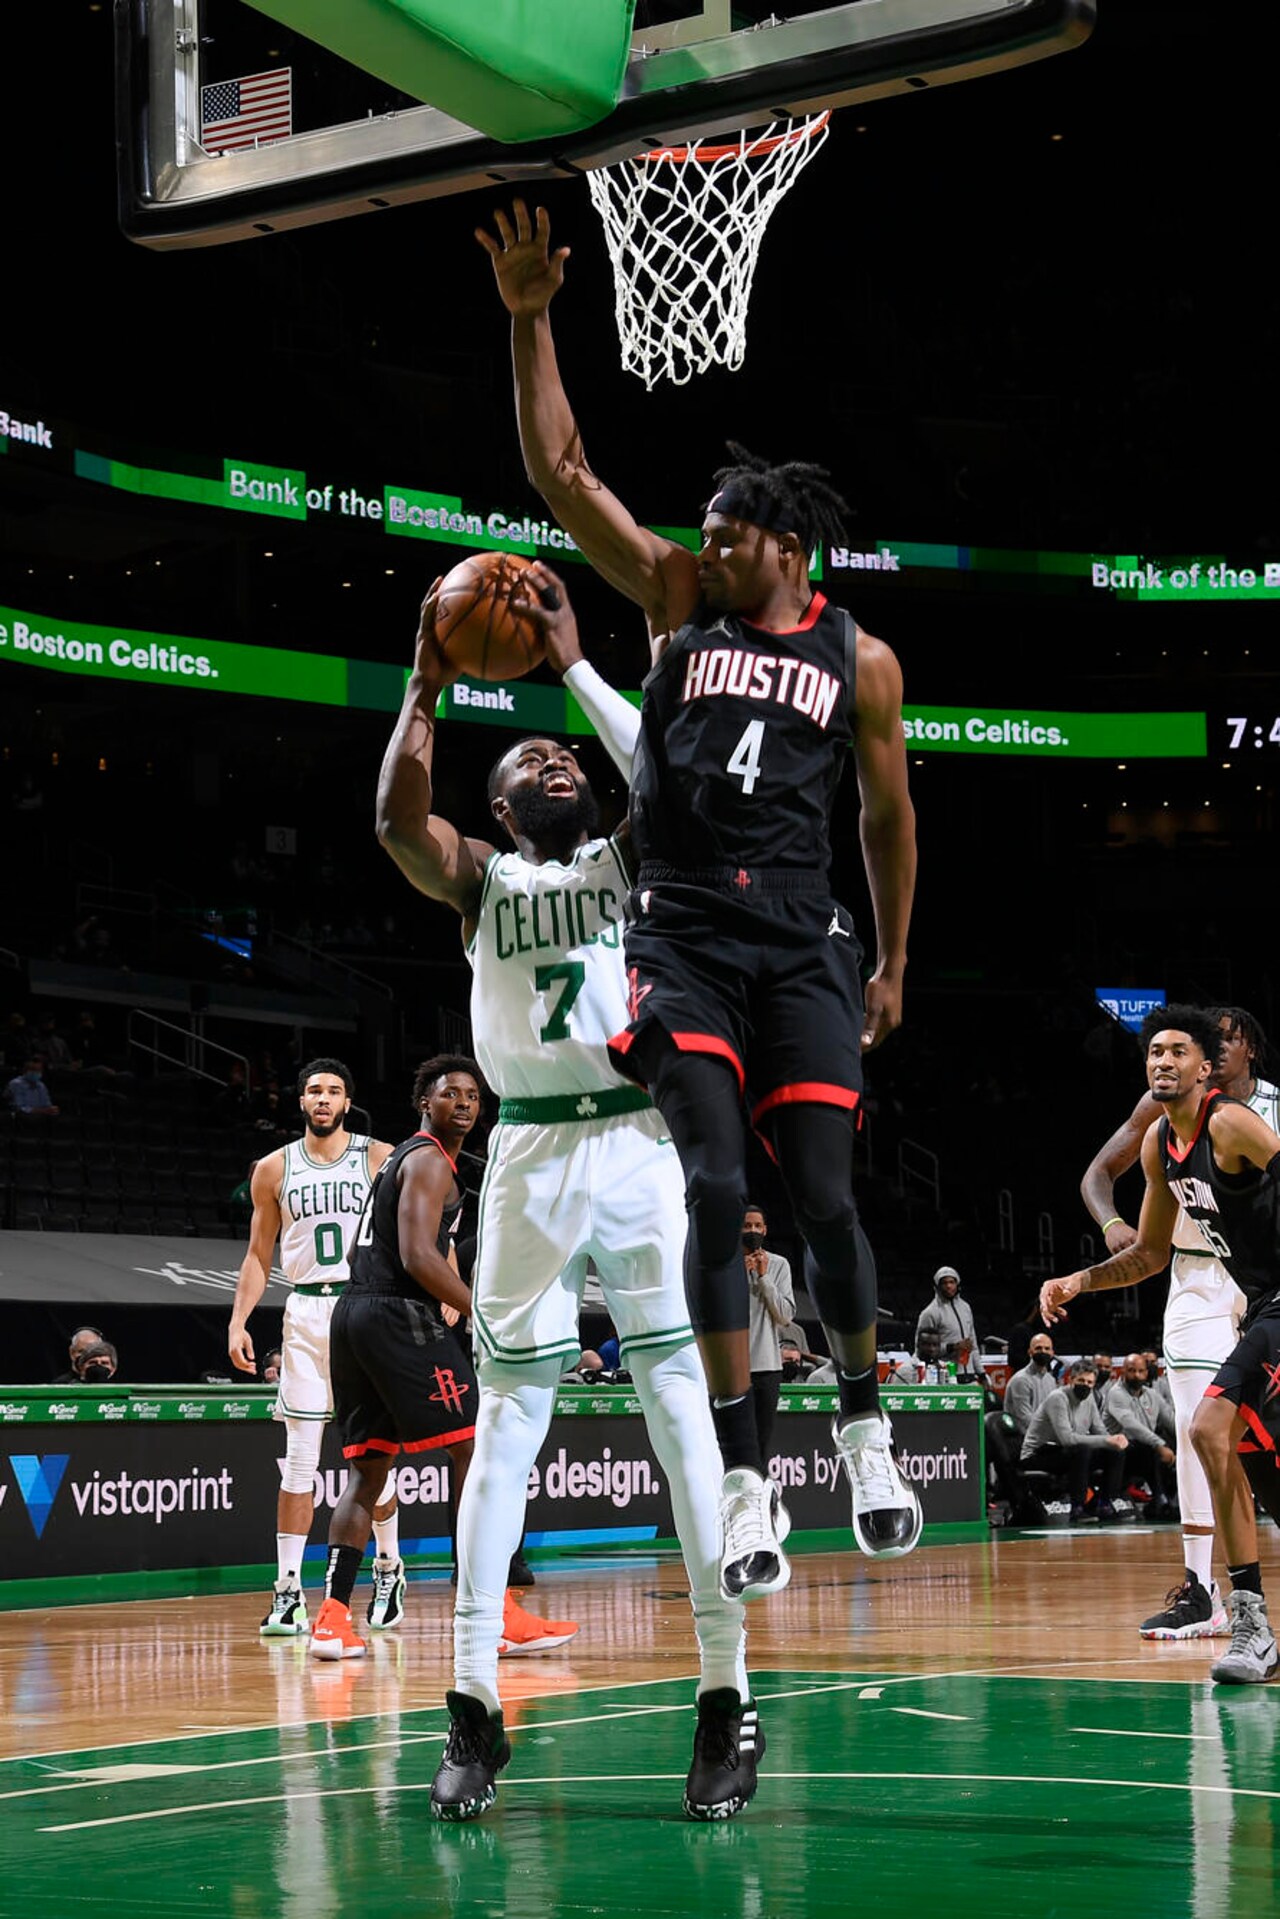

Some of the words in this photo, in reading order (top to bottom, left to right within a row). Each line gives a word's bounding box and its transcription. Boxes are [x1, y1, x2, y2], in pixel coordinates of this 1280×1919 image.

[0, 411, 52, 449] Bank
[230, 469, 299, 506] Bank
[306, 485, 333, 511] of
[339, 488, 383, 519] the
[389, 496, 483, 536] Boston
[831, 546, 900, 571] Bank
[1092, 563, 1163, 588] Bank
[1170, 563, 1201, 588] of
[1207, 563, 1256, 588] the
[14, 622, 103, 664] Boston
[109, 639, 219, 678] Celtics.
[453, 683, 515, 711] Bank
[683, 649, 841, 732] HOUSTON
[727, 719, 766, 795] 4
[902, 718, 960, 741] ston
[965, 718, 1069, 746] Celtics.
[495, 888, 620, 960] CELTICS
[534, 961, 585, 1043] 7
[288, 1181, 367, 1221] CELTICS
[314, 1222, 343, 1266] 0
[545, 1447, 660, 1508] design.
[814, 1450, 841, 1492] by
[901, 1446, 968, 1488] taprint
[71, 1467, 233, 1524] vistaprint
